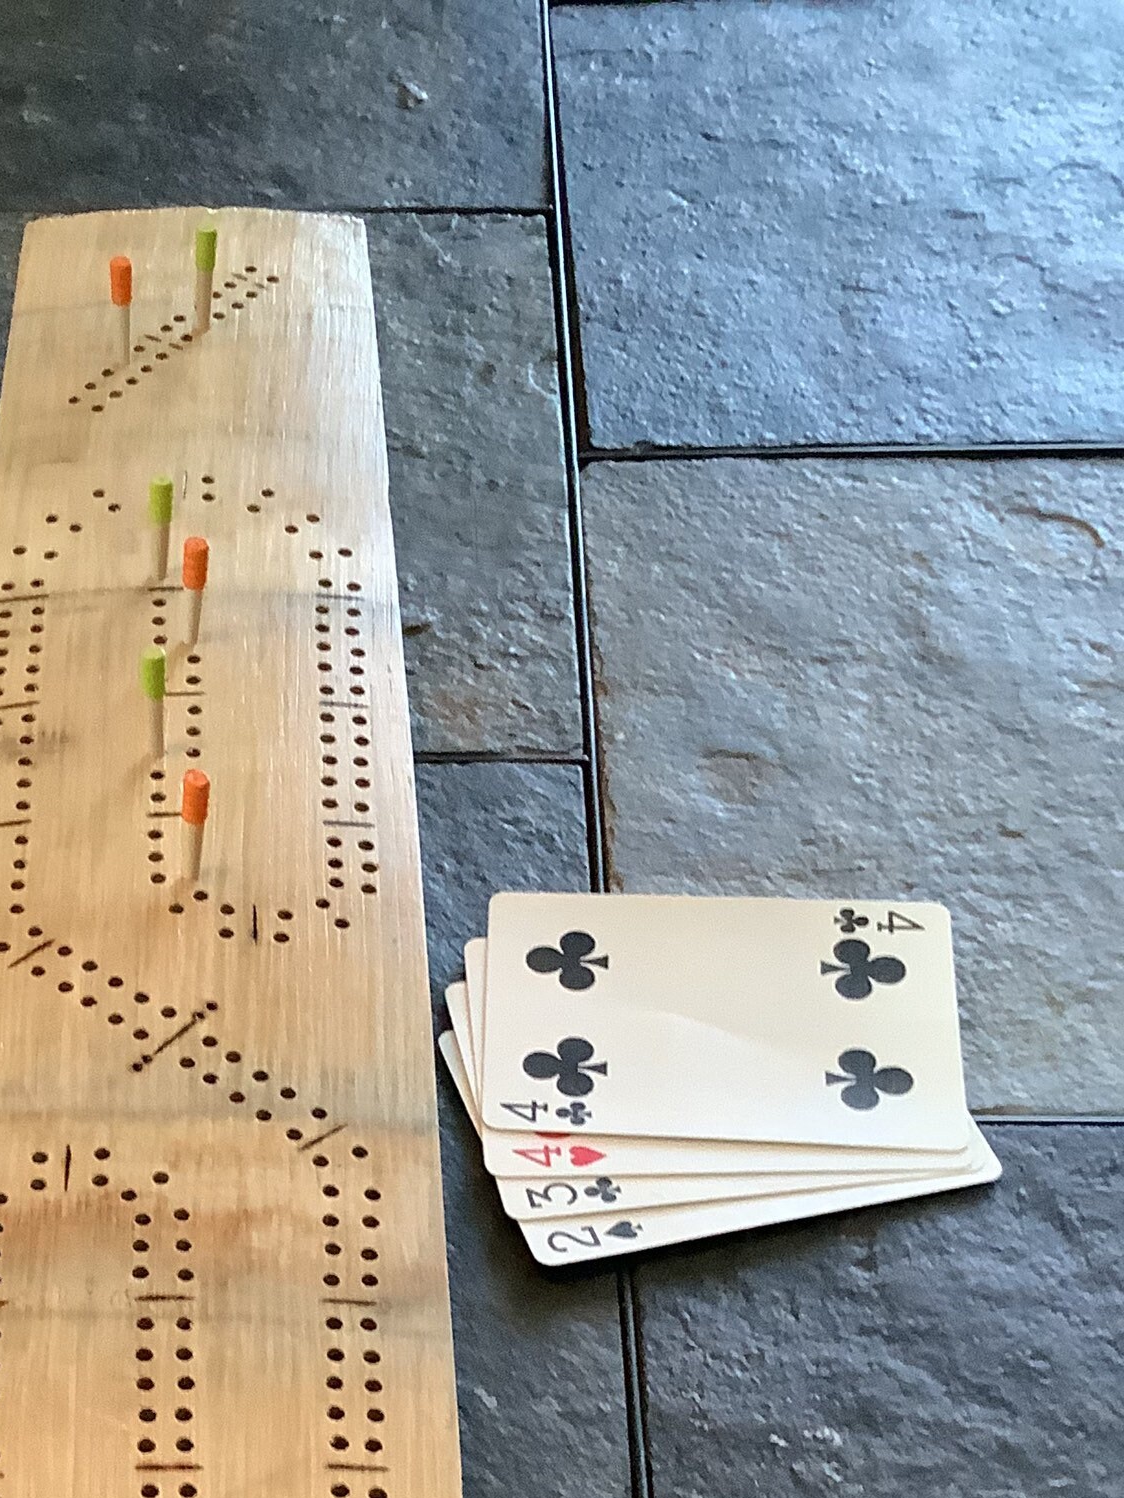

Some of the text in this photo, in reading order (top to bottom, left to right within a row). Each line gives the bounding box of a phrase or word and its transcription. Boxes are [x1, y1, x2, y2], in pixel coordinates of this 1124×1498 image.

[876, 911, 925, 933] 4
[500, 1101, 549, 1122] 4
[513, 1146, 562, 1167] 4
[526, 1182, 578, 1209] 3
[547, 1226, 601, 1252] 2
